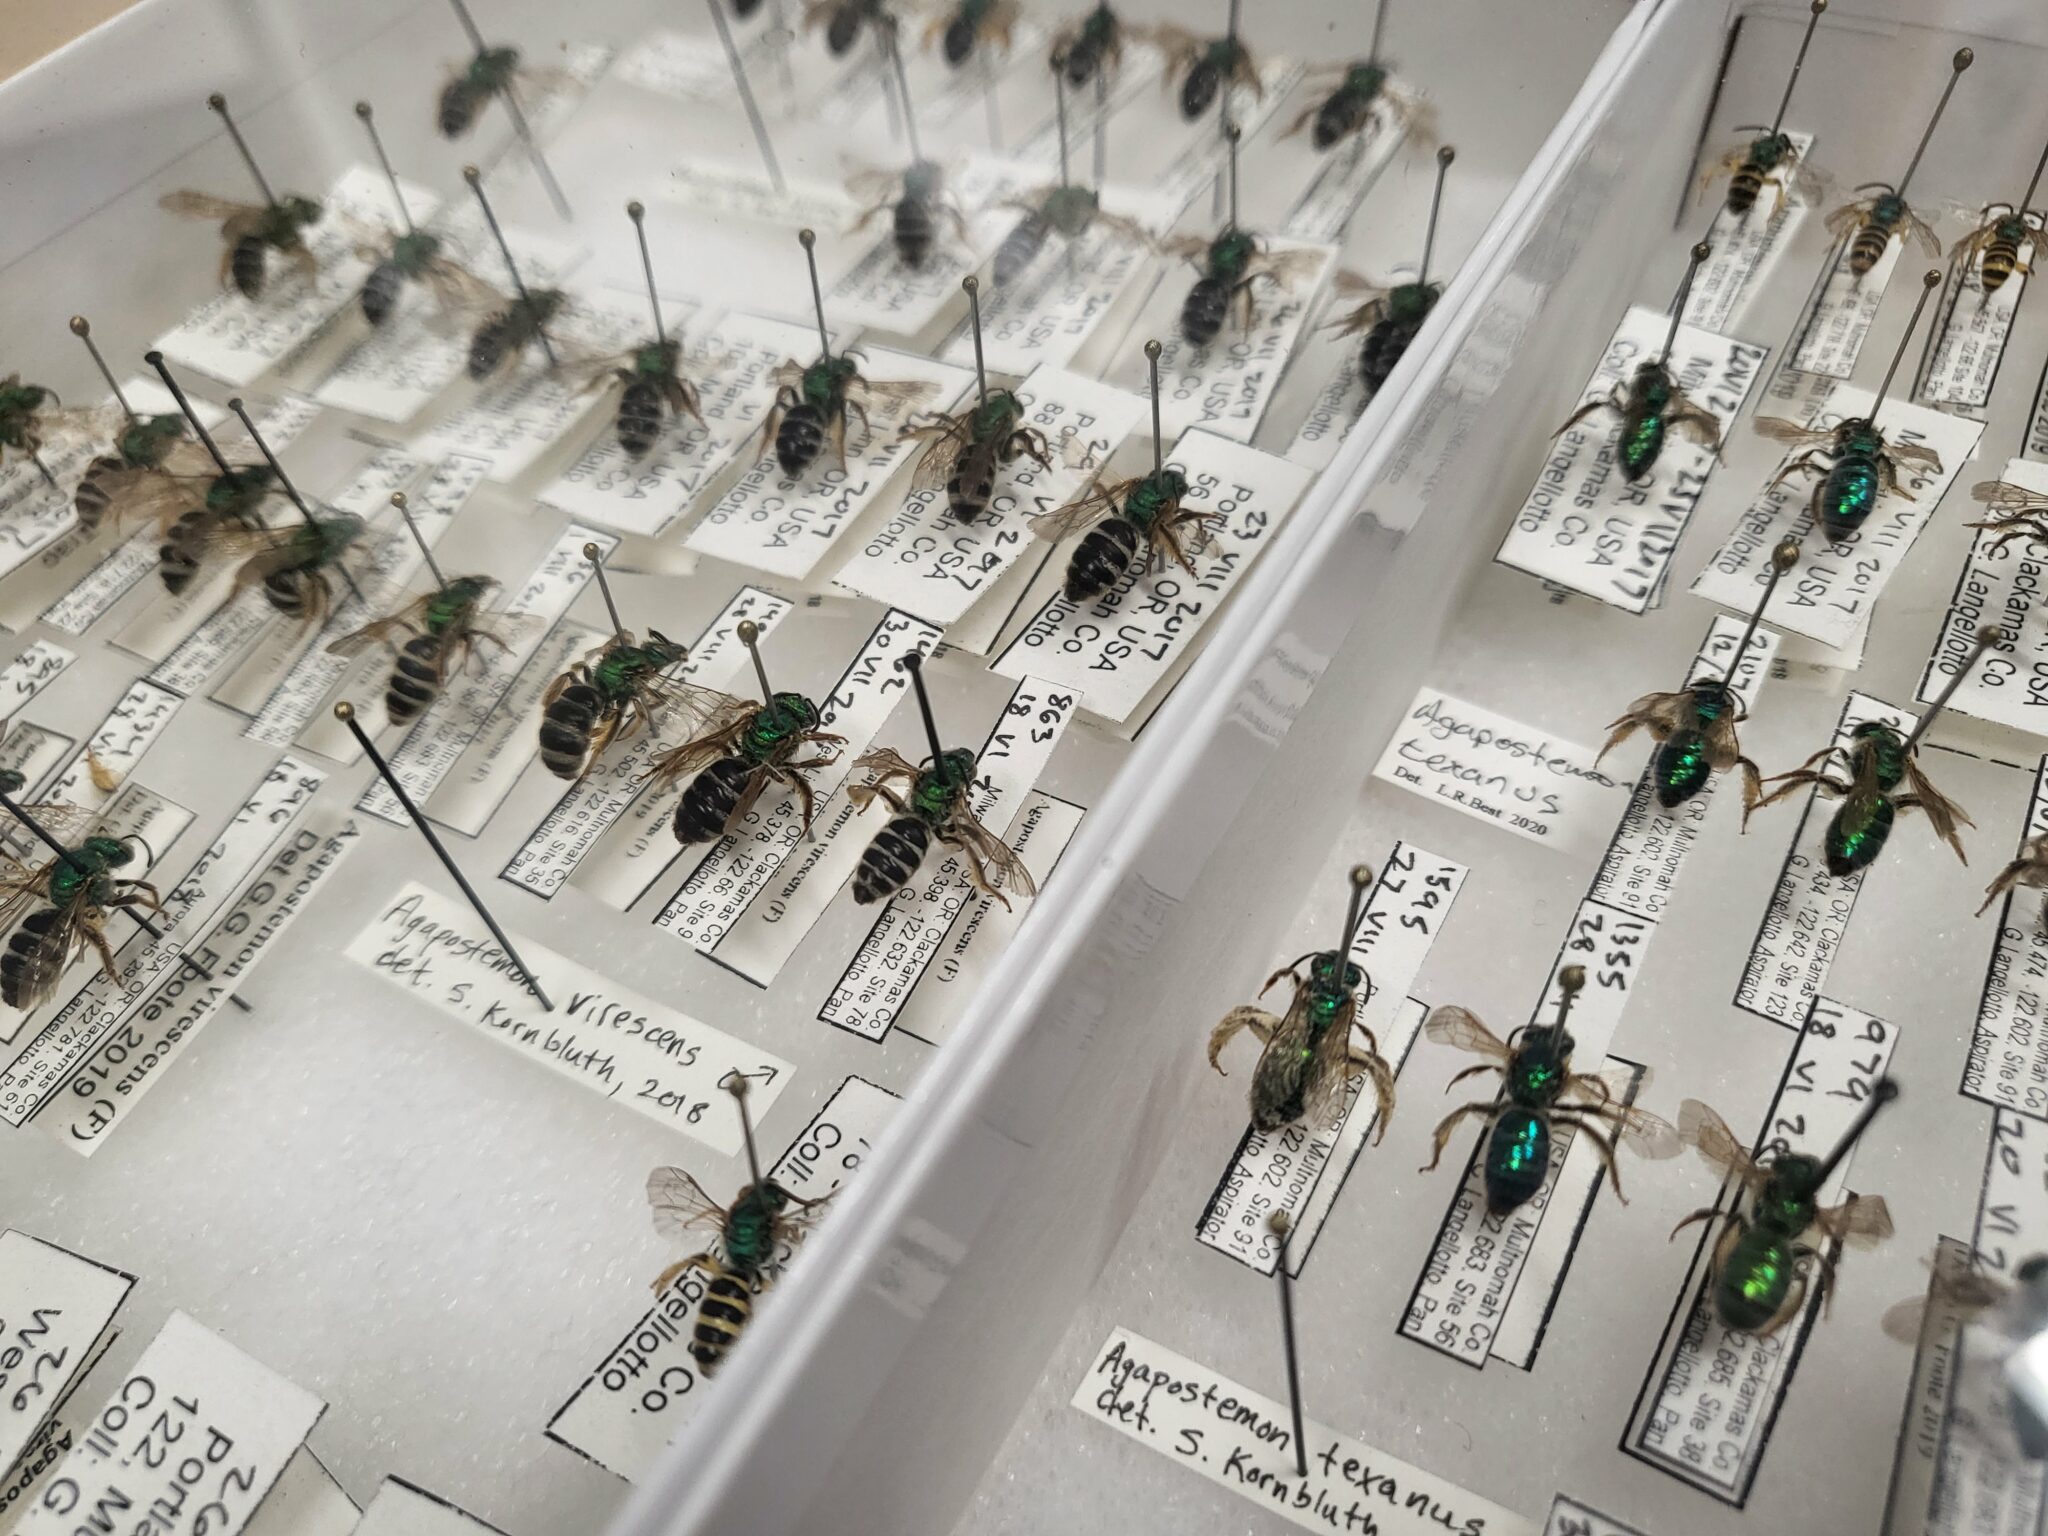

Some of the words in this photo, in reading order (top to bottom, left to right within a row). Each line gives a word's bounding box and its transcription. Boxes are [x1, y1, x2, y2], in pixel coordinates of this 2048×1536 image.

[1195, 382, 1233, 432] USA
[812, 467, 869, 547] 2017
[1185, 473, 1220, 500] 56
[762, 507, 816, 548] USA
[1232, 511, 1268, 541] 23
[1555, 515, 1590, 547] Co.
[1586, 517, 1633, 566] USA
[1717, 477, 1800, 581] Langellotto
[1872, 512, 1916, 548] VIII
[891, 526, 940, 579] Co.
[922, 524, 980, 581] USA
[1196, 550, 1240, 592] VIII
[1130, 569, 1181, 615] OR,
[1786, 565, 1837, 607] USA
[1829, 546, 1880, 615] 2017
[874, 610, 910, 648] 30
[1056, 624, 1101, 655] Co.
[1141, 590, 1202, 661] 2017
[1928, 565, 1998, 682] Langellotto
[1089, 625, 1146, 671] USA
[852, 656, 883, 686] VII
[1003, 685, 1037, 717] 18
[1031, 693, 1073, 743] 863
[982, 725, 1021, 767] VI
[1411, 699, 1634, 796] Agapostemon
[1397, 738, 1562, 817] texanus
[1393, 765, 1422, 786] Det.
[1509, 813, 1548, 836] 2020
[269, 829, 320, 877] Det
[539, 839, 567, 865] Site
[560, 799, 623, 873] Multnomah
[506, 844, 536, 875] Pan
[524, 866, 546, 886] 35
[781, 833, 835, 899] virescens
[1377, 842, 1415, 894] 27
[1592, 840, 1632, 905] Aspirator
[1626, 864, 1652, 889] Site
[1654, 825, 1698, 892] Multnomah
[223, 820, 358, 978] Agapostemon
[544, 868, 567, 896] Co.
[717, 852, 781, 930] Clackamas
[1399, 867, 1456, 935] 1595
[1618, 891, 1641, 909] 91
[215, 881, 276, 937] G.G.
[656, 897, 688, 927] Pan
[686, 899, 716, 926] Site
[761, 900, 786, 923] (F)
[934, 897, 962, 921] OR:
[1824, 899, 1851, 925] OR:
[673, 922, 696, 944] 9
[695, 923, 723, 950] Co.
[1348, 911, 1387, 954] VIII
[1569, 914, 1604, 953] 28
[884, 928, 947, 1004] Clackamas
[936, 958, 960, 983] (F)
[1596, 922, 1645, 991] 1355
[1734, 941, 1775, 1005] Aspirator
[1774, 961, 1799, 988] Site
[1799, 927, 1841, 1002] Clackamas
[382, 894, 541, 997] Agapostemon
[567, 990, 703, 1067] virescens
[858, 975, 887, 1004] Site
[819, 982, 854, 1023] Pan
[845, 1007, 869, 1030] 78
[861, 1000, 896, 1039] Co.
[1764, 991, 1789, 1018] 123
[1804, 1001, 1844, 1039] 18
[38, 1002, 119, 1097] Clackamas
[115, 975, 223, 1096] virescens
[374, 948, 432, 989] det.
[447, 983, 474, 1012] S.
[480, 999, 625, 1098] Kornbluth,
[637, 1078, 711, 1125] 2018
[17, 1059, 49, 1089] Site
[72, 1018, 144, 1098] 2019
[1784, 1056, 1817, 1093] VI
[1959, 1023, 1998, 1096] Aspirator
[1999, 1050, 2025, 1080] Site
[11, 1093, 40, 1125] Co.
[1994, 1082, 2019, 1105] 91
[71, 1099, 116, 1141] (F)
[780, 1122, 842, 1184] Coll:
[1985, 1113, 2024, 1175] 20
[1197, 1160, 1253, 1240] Aspirator
[1241, 1193, 1272, 1227] Site
[1985, 1204, 2020, 1235] VI
[1228, 1229, 1254, 1254] 91
[1256, 1231, 1285, 1260] Co.
[1478, 1218, 1539, 1318] Multnomah
[1401, 1290, 1438, 1332] Pan
[1445, 1278, 1477, 1316] Site
[1434, 1319, 1462, 1348] 56
[12, 1345, 70, 1412] 26
[632, 1366, 694, 1413] Co.
[1725, 1331, 1781, 1436] Clackamas
[78, 1374, 157, 1466] Coll:
[119, 1395, 201, 1468] 122,
[1096, 1388, 1157, 1434] det.
[1174, 1428, 1209, 1463] S.
[1643, 1404, 1680, 1445] Pan
[1689, 1392, 1722, 1432] Site
[1096, 1340, 1293, 1452] Agapostemon
[1318, 1441, 1487, 1536] texanus
[1678, 1434, 1707, 1464] 38
[194, 1464, 257, 1536] 26
